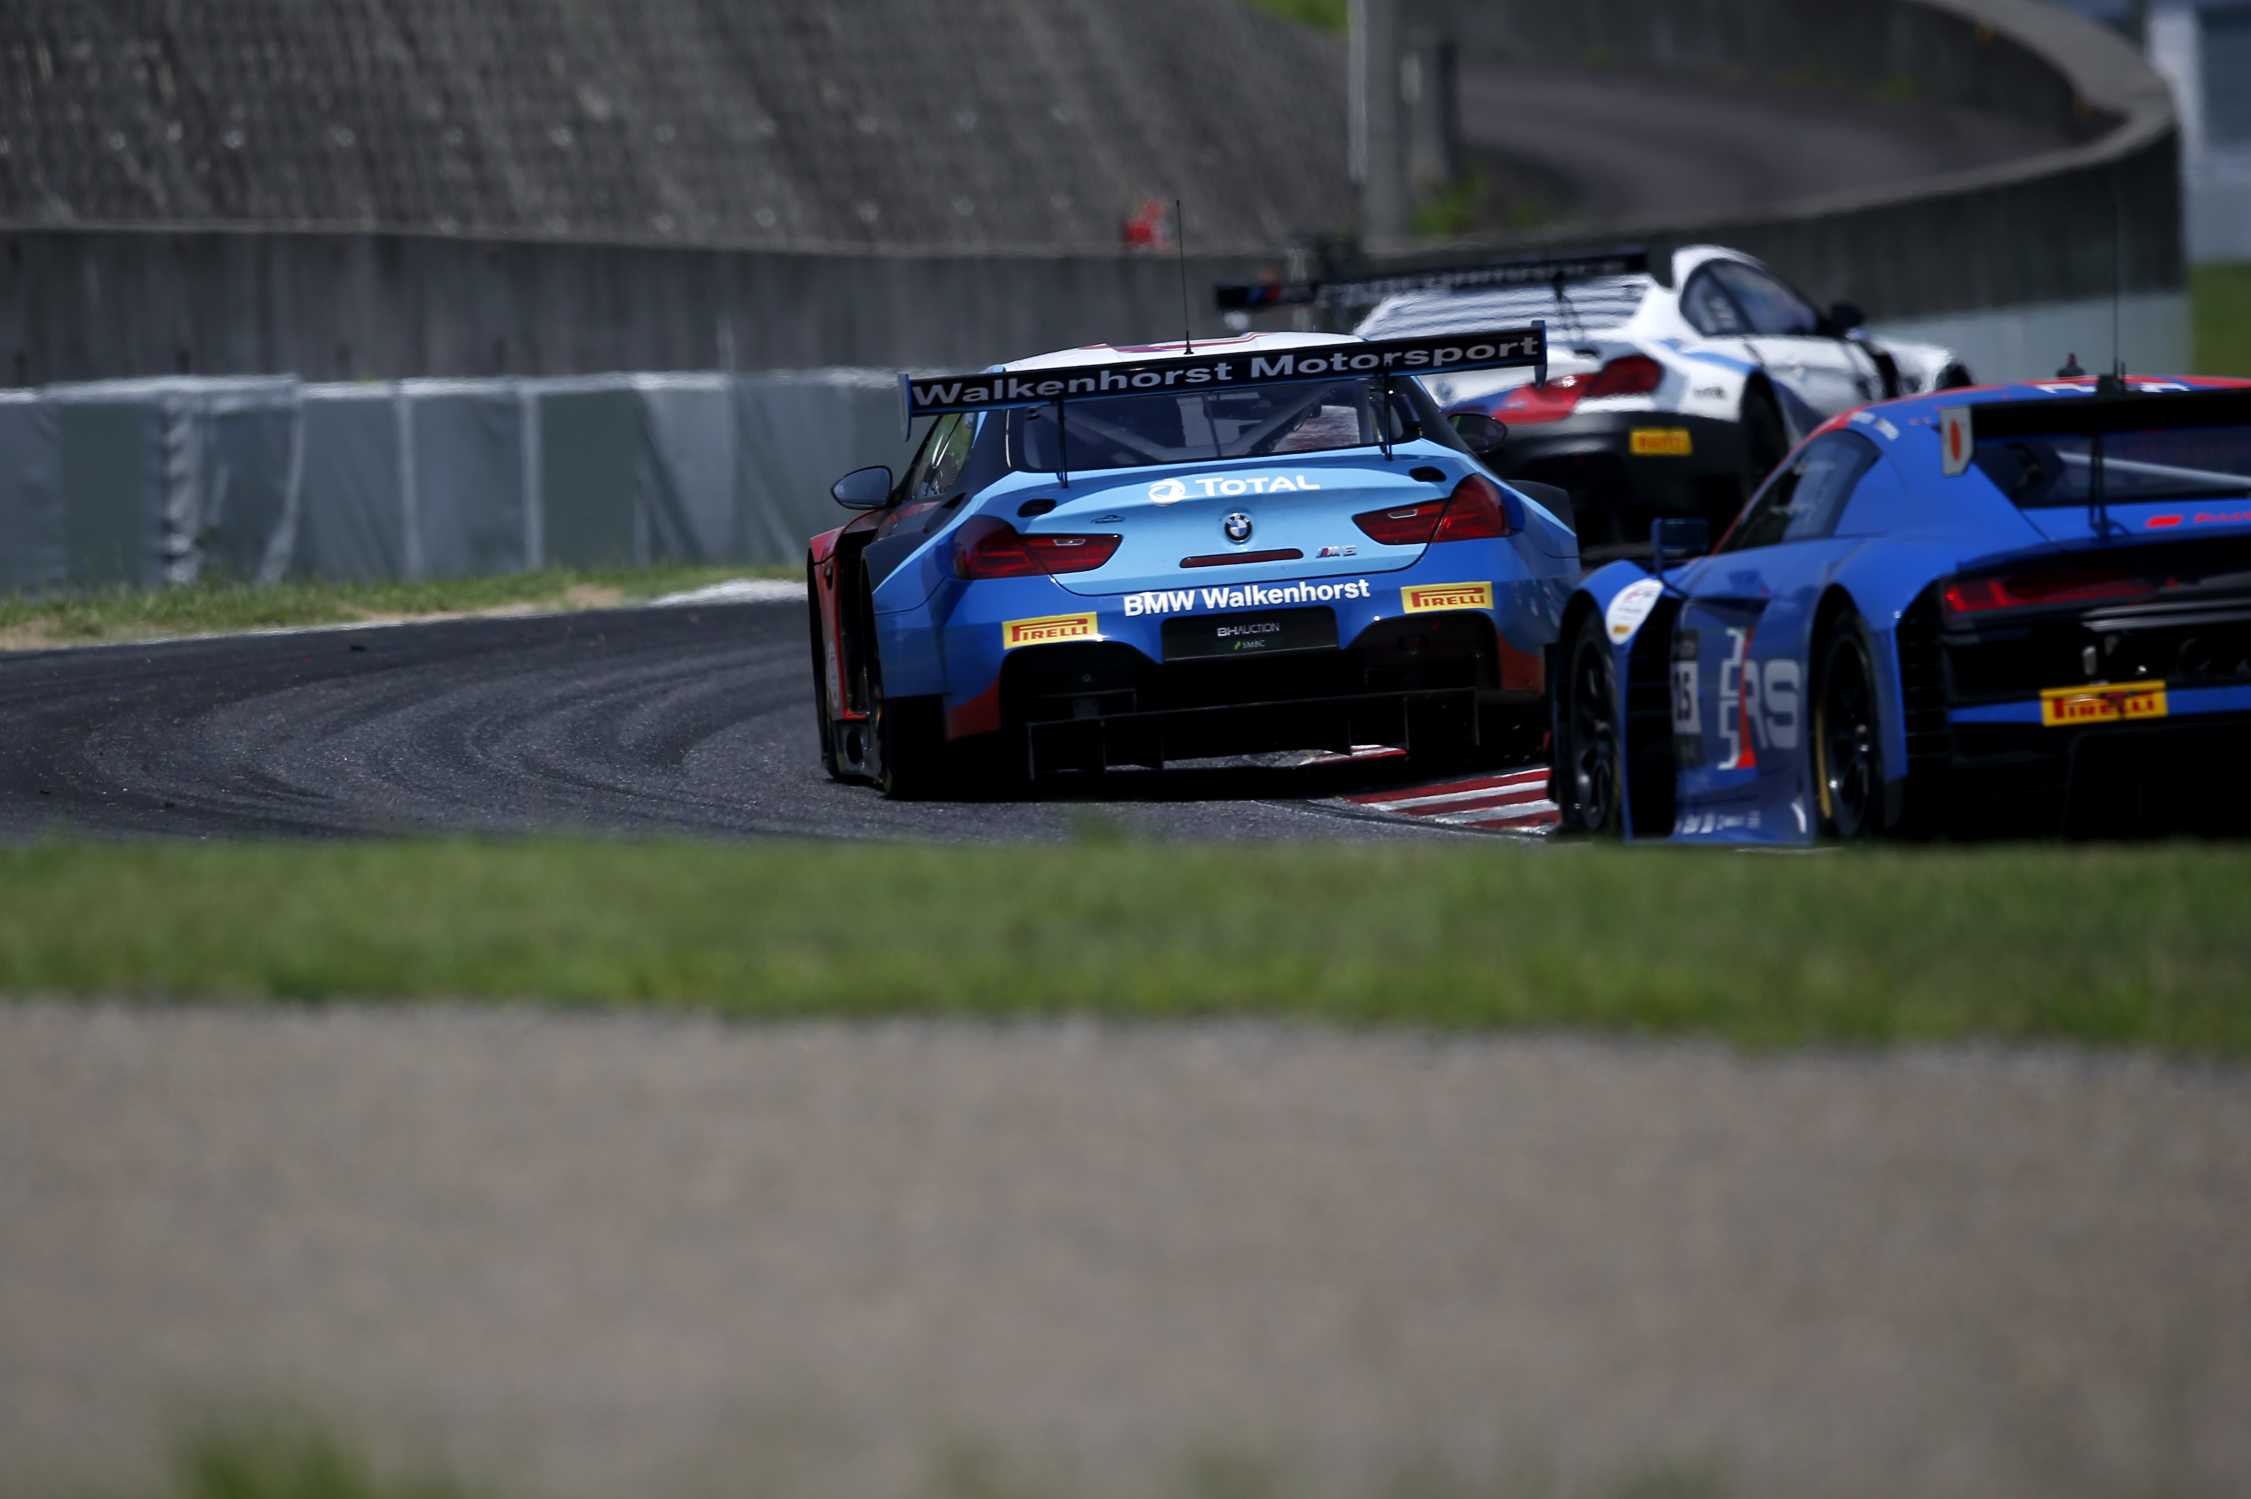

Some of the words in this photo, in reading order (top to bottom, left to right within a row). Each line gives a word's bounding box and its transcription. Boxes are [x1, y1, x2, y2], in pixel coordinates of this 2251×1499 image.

[911, 362, 1233, 406] Walkenhorst
[1249, 336, 1539, 379] Motorsport
[1195, 475, 1321, 497] TOTAL
[1123, 589, 1196, 617] BMW
[1201, 579, 1371, 609] Walkenhorst
[1411, 587, 1485, 608] PIRELLI
[1011, 618, 1089, 642] PIRELLI
